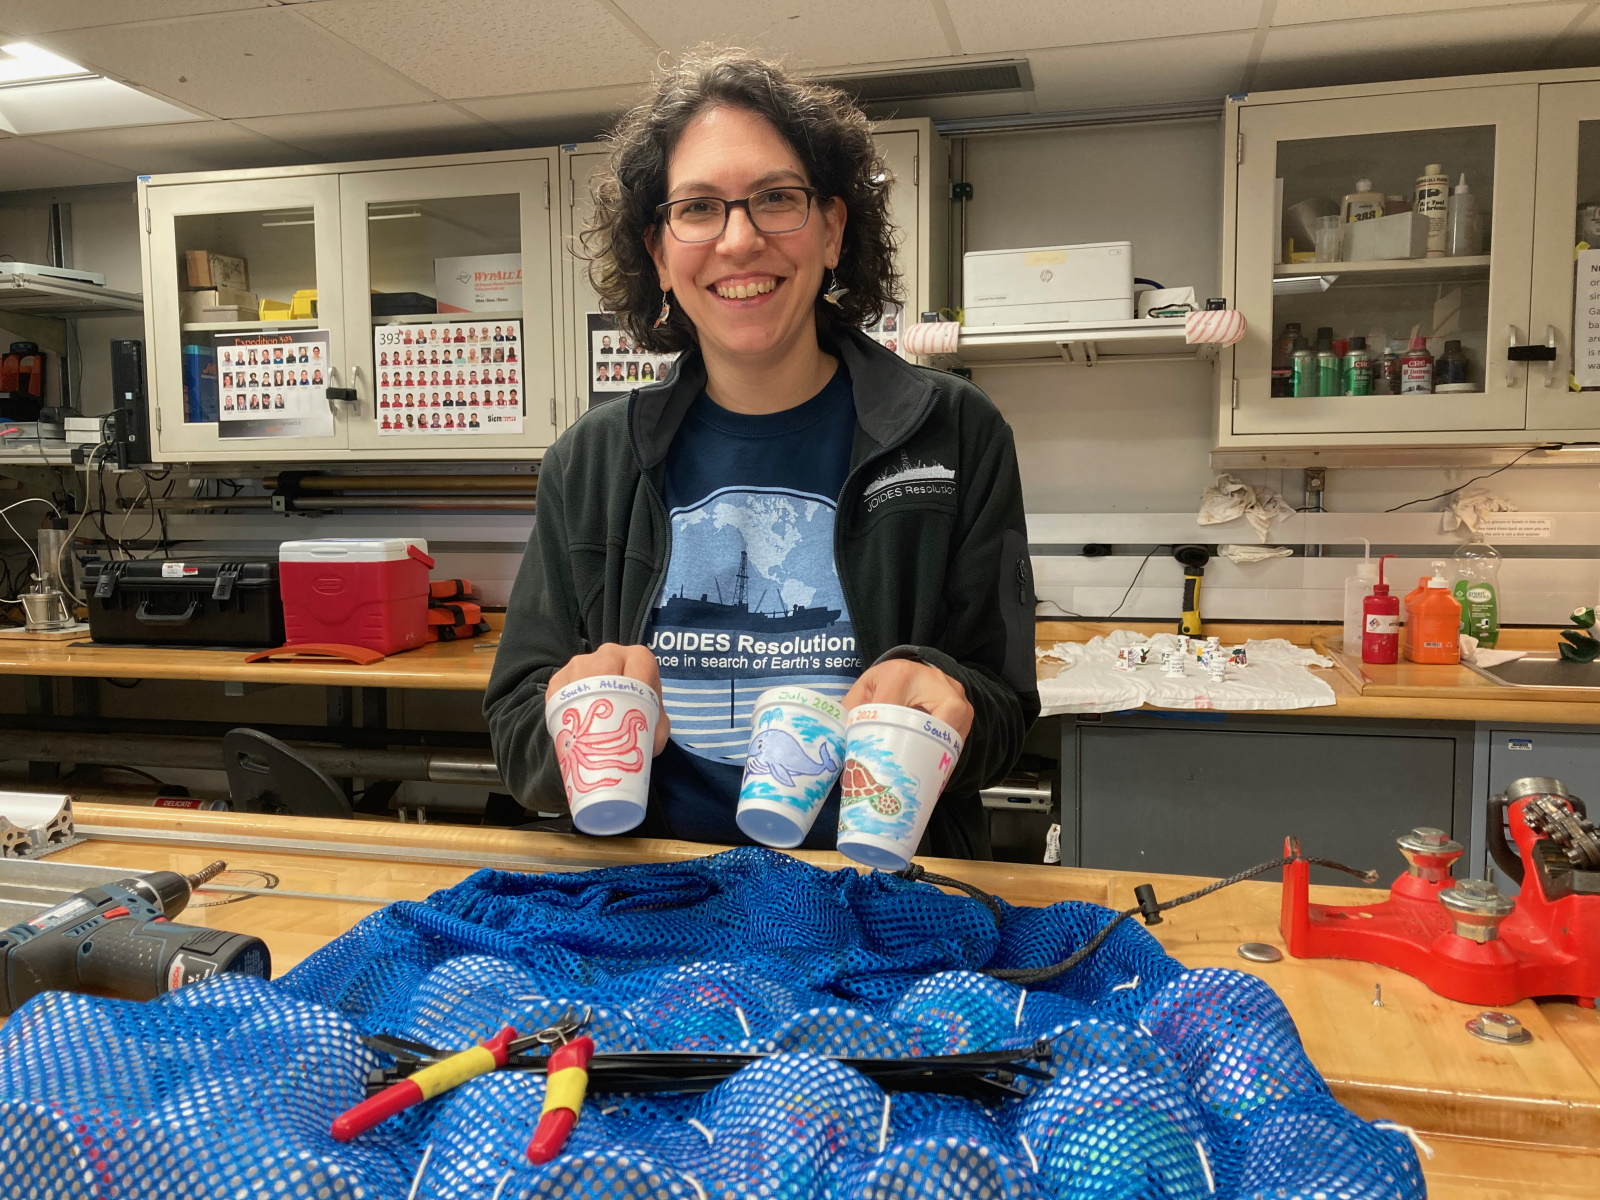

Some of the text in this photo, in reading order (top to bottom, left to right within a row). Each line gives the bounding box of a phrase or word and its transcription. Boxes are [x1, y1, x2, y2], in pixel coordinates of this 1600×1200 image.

[379, 332, 401, 345] 393
[867, 487, 903, 513] JOIDES
[646, 631, 855, 655] JOIDES Resolution
[655, 653, 862, 669] nce in search of Earth's secre
[559, 684, 591, 701] South
[599, 680, 645, 696] Atlantic
[778, 691, 842, 720] July 2022
[855, 709, 878, 721] 2022
[923, 720, 952, 744] South
[162, 800, 192, 808] DELICATE
[172, 966, 182, 990] OSCH
